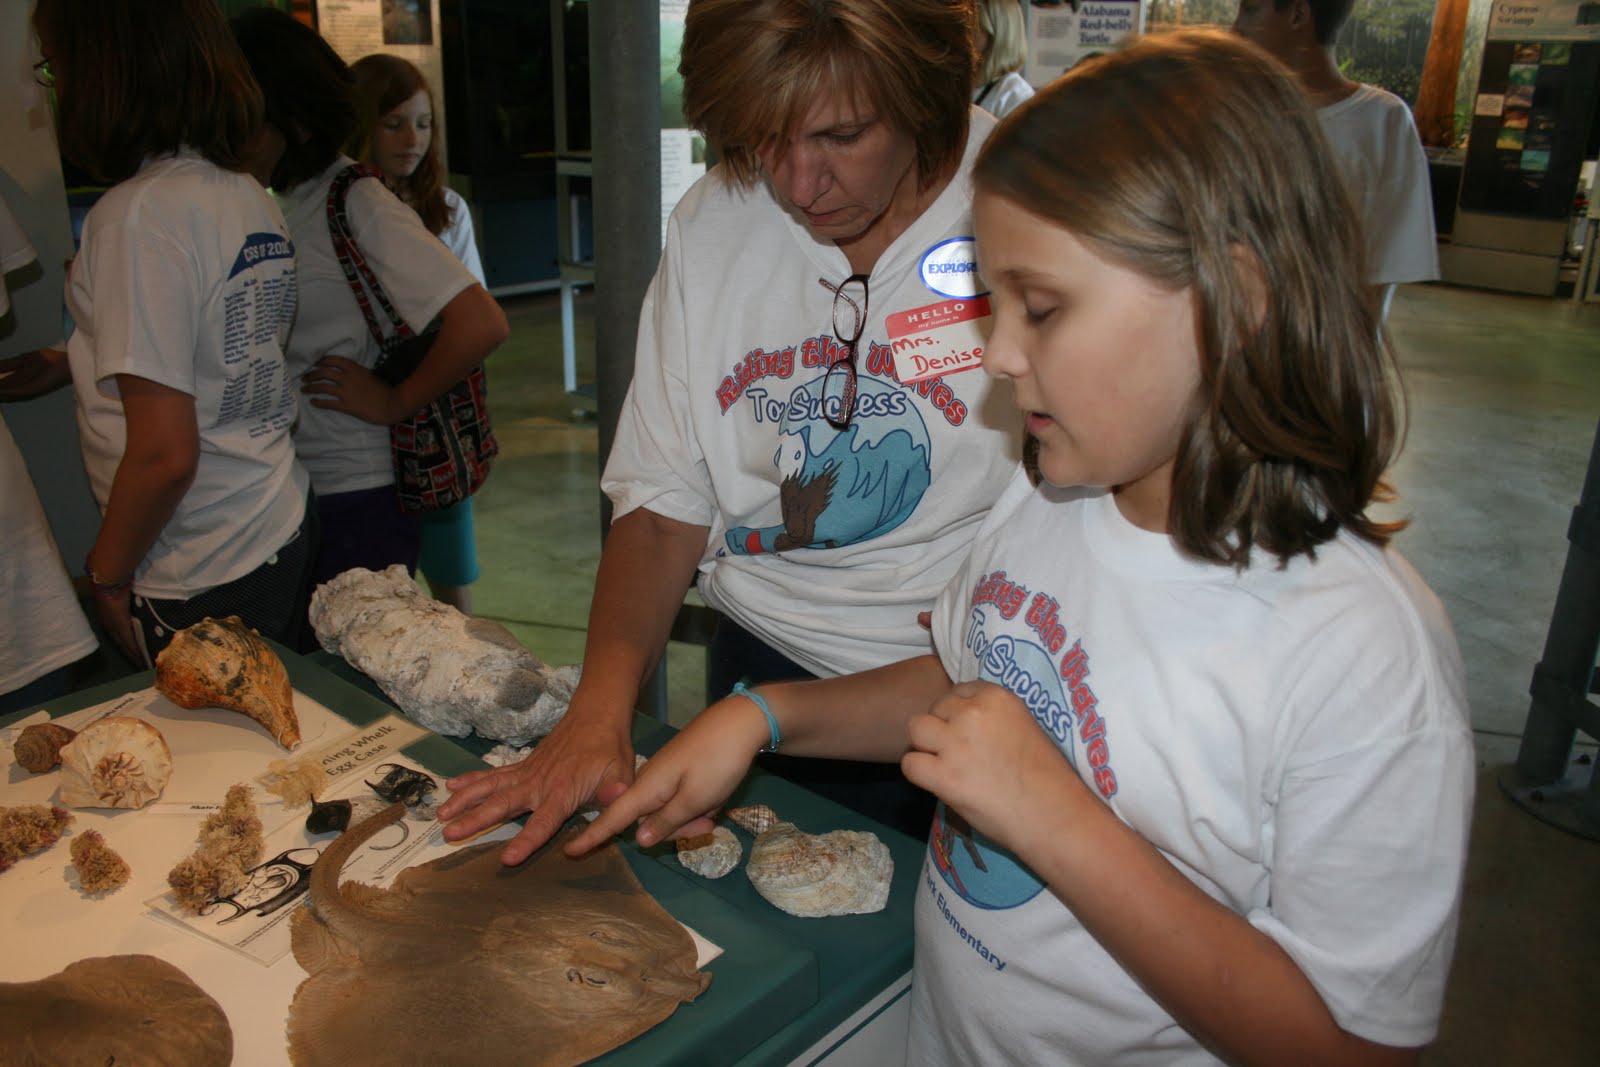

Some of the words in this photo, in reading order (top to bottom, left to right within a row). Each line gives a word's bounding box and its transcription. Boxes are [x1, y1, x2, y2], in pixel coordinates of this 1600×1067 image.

[1080, 19, 1132, 31] Red-belly
[1081, 5, 1130, 17] Alabama
[1080, 32, 1111, 43] Turtle
[907, 303, 965, 323] HELLO
[918, 321, 929, 329] my
[930, 317, 951, 326] name
[891, 336, 940, 354] Mrs.
[909, 347, 984, 376] Denise
[715, 344, 798, 416] Riding
[800, 335, 852, 370] the
[865, 340, 968, 427] Wves
[746, 388, 786, 423] To
[788, 385, 906, 423] Sucess
[967, 608, 988, 658] To
[985, 635, 1073, 743] Success
[1025, 592, 1067, 655] the
[1061, 638, 1118, 799] Waves
[322, 747, 356, 766] ning
[351, 725, 397, 748] Whelk
[325, 761, 357, 776] Egg
[354, 743, 388, 761] Case
[937, 892, 1007, 971] Elementary
